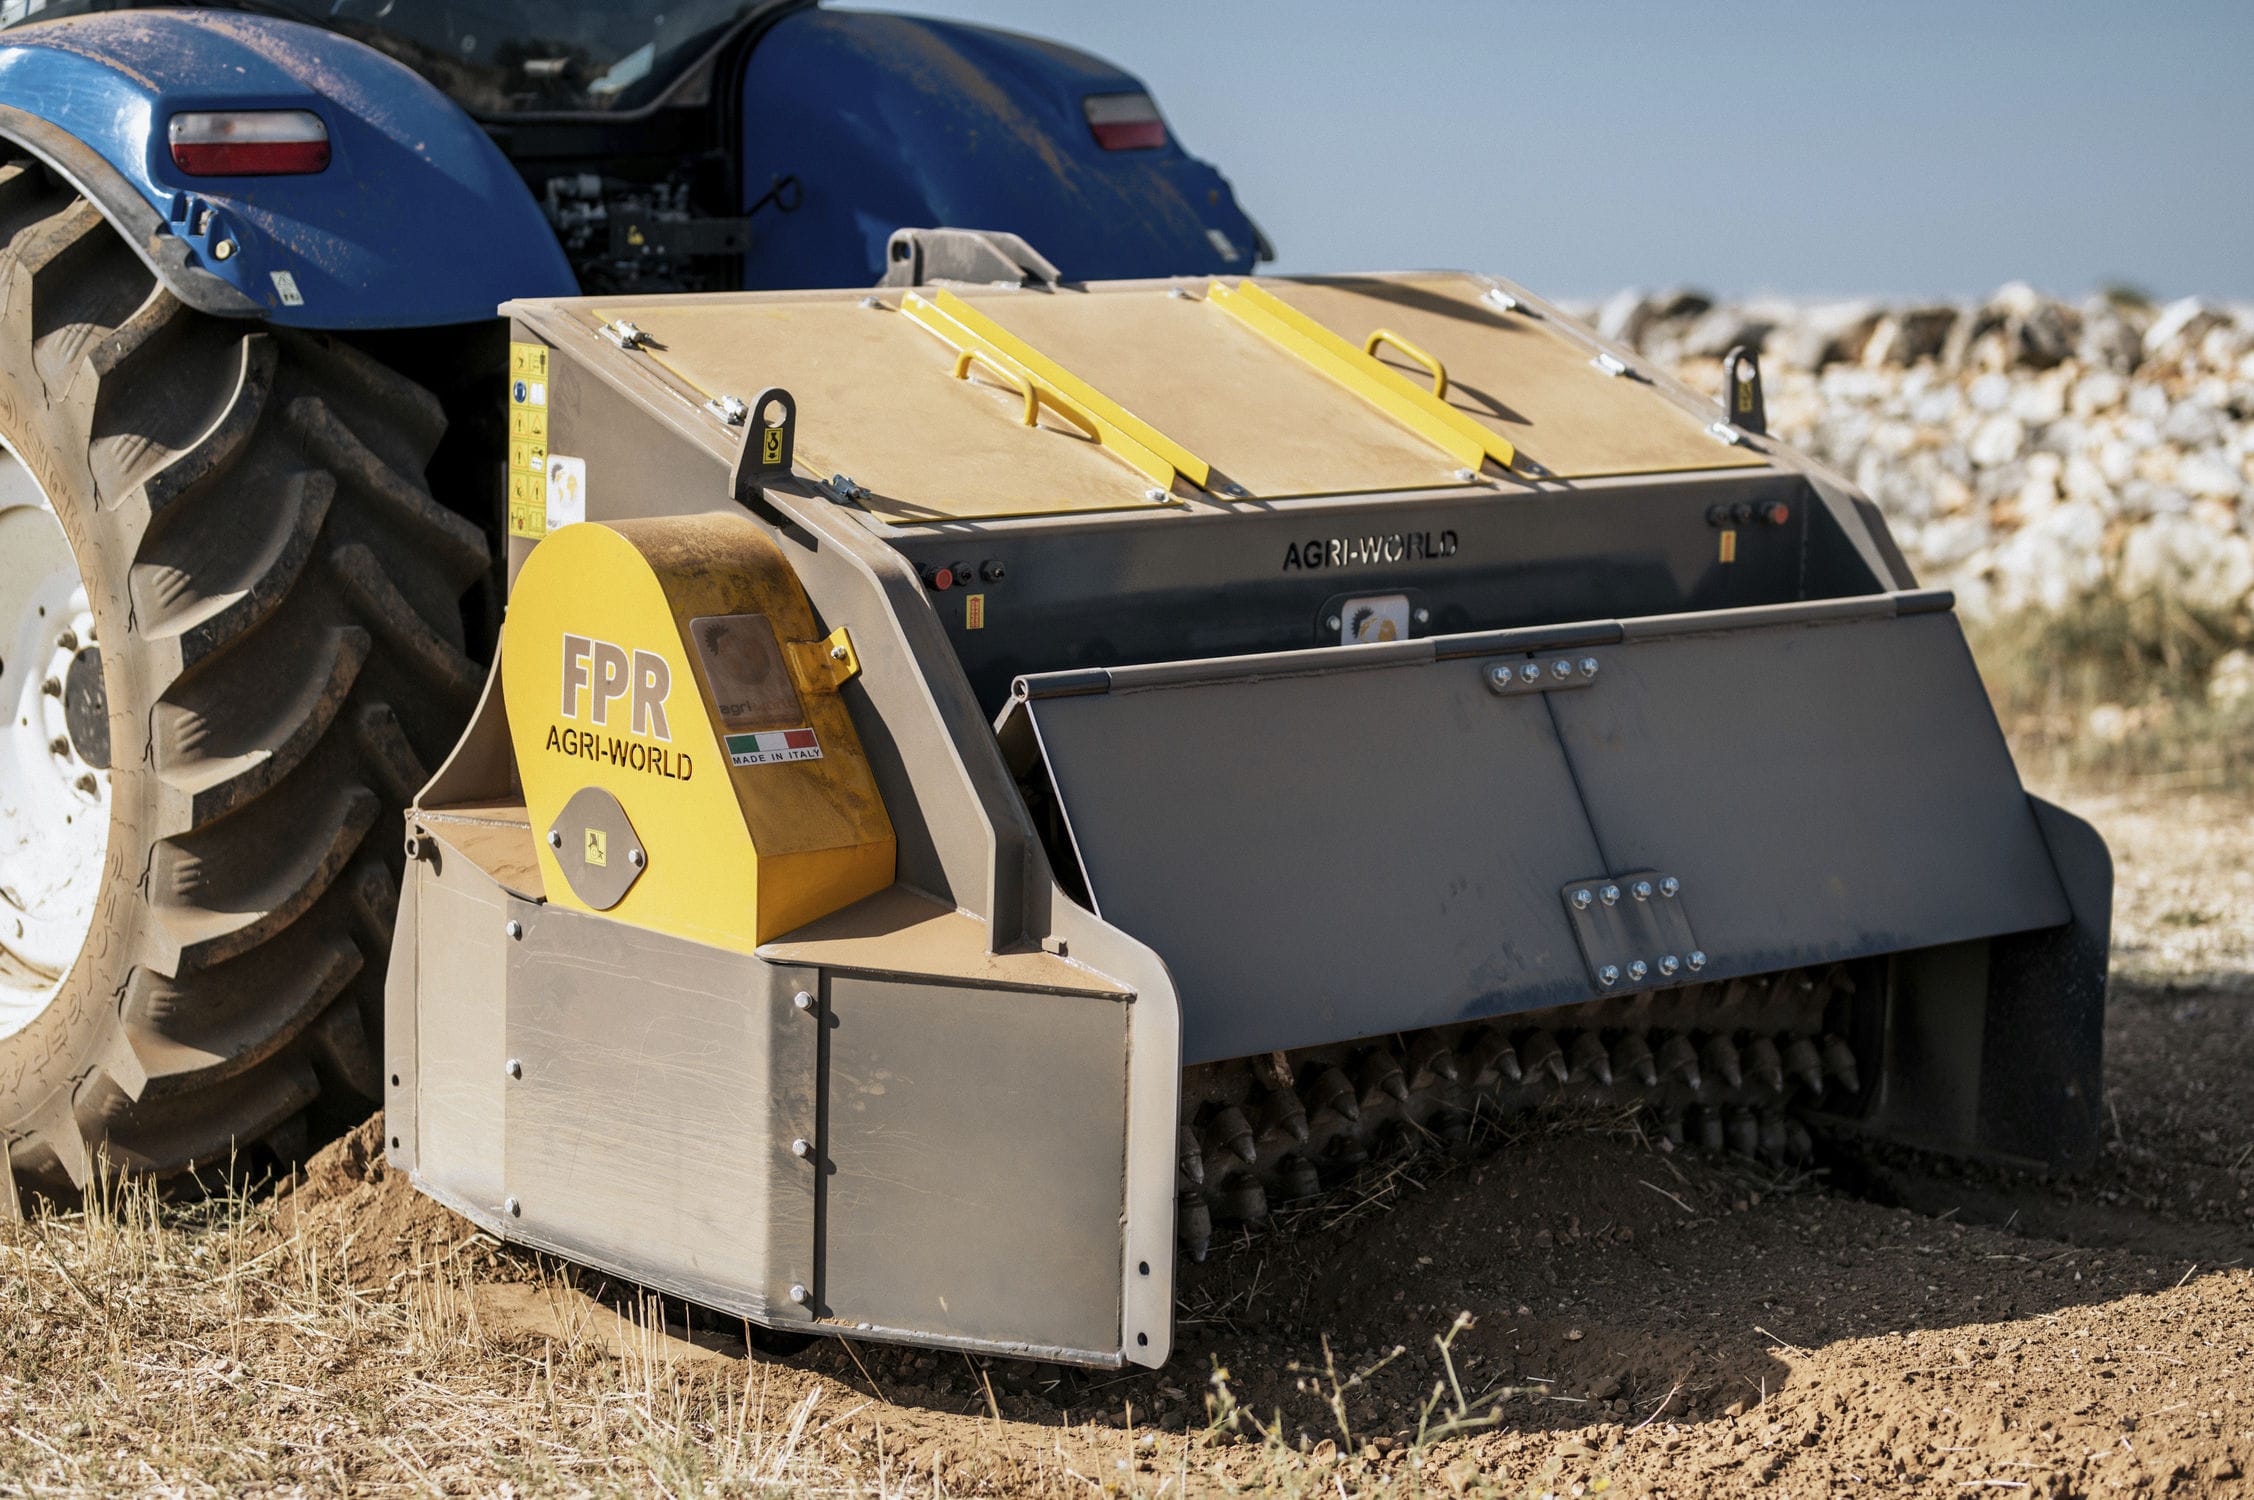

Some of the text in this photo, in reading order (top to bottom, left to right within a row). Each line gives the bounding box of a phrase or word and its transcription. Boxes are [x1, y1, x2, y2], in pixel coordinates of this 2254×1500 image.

[1282, 529, 1458, 572] AGRI-WORLD
[561, 632, 672, 743] FPR
[546, 724, 693, 781] AGRI-WORLD
[732, 749, 821, 765] MADE IN ITALY
